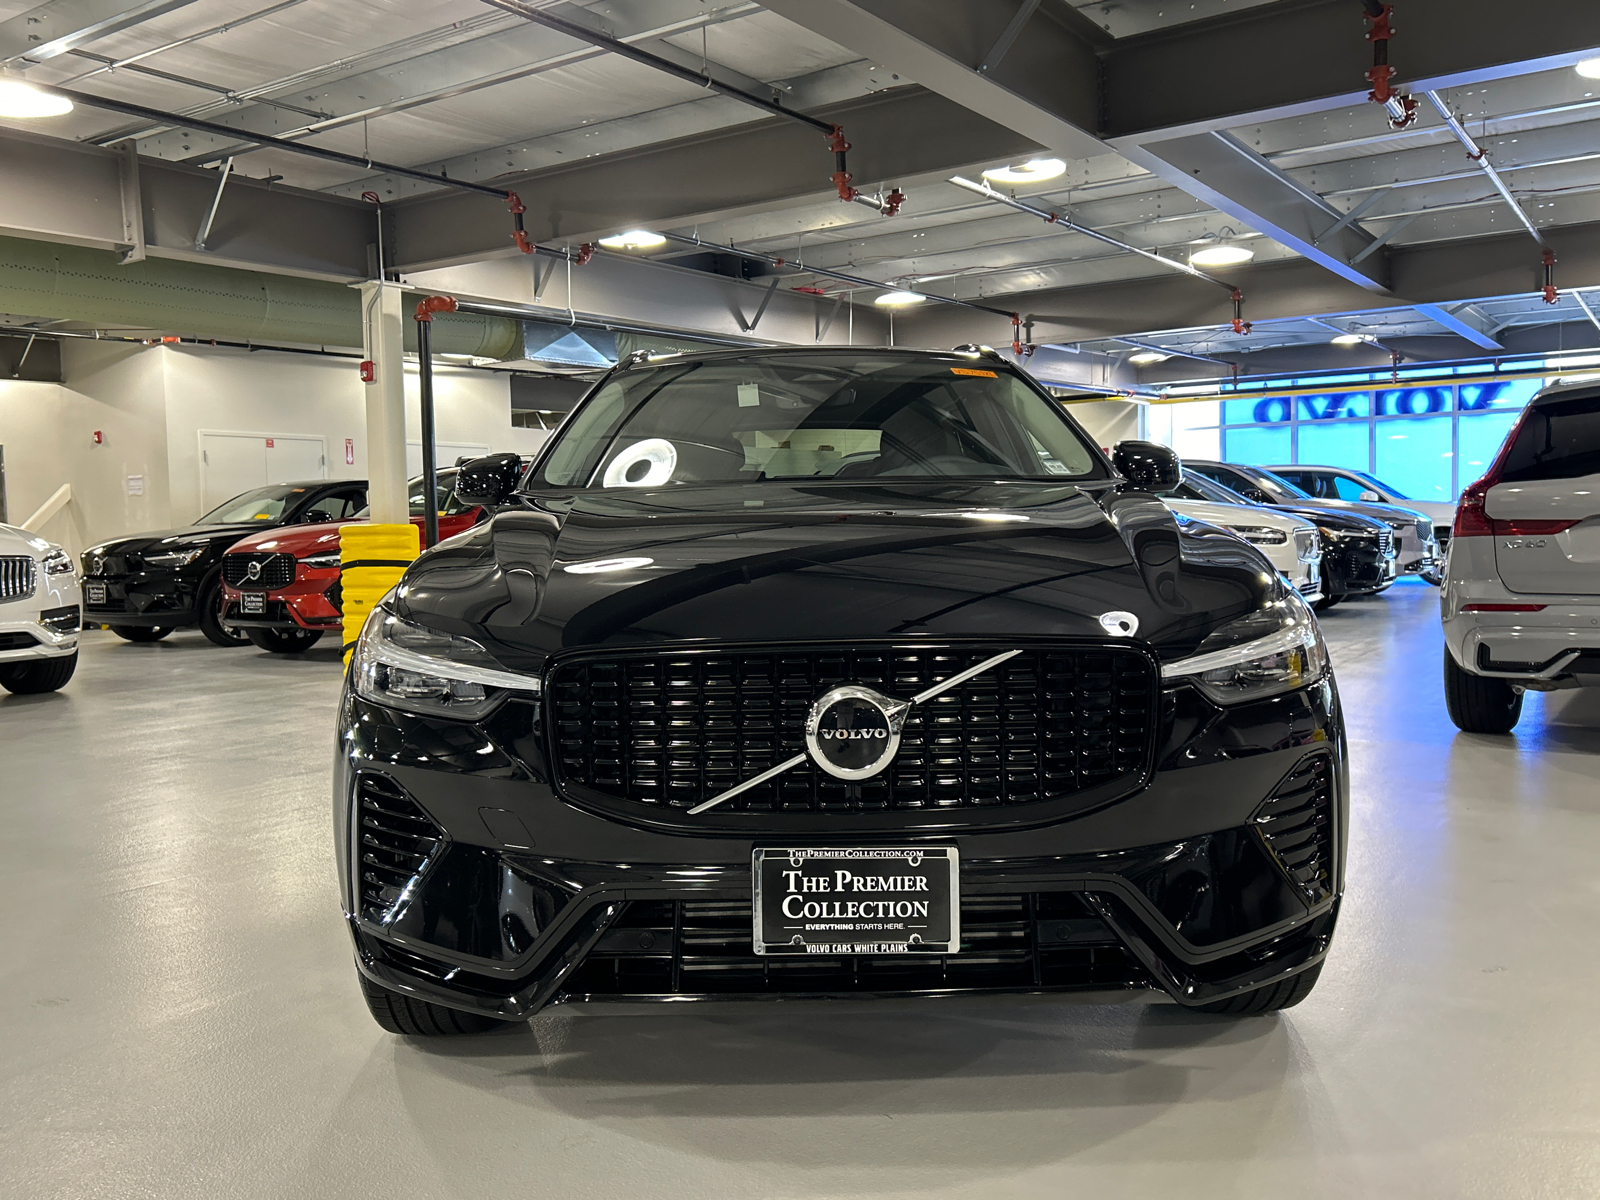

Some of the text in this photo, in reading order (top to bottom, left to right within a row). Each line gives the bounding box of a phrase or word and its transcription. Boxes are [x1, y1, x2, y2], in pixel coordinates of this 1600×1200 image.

[820, 728, 887, 739] VOLVO
[782, 870, 929, 893] THE PREMIER
[782, 895, 930, 919] COLLECTION
[805, 923, 854, 931] EVERYTHING
[884, 922, 906, 930] HERE.
[806, 943, 908, 953] VOLVO CARS WHITE PLAINS
